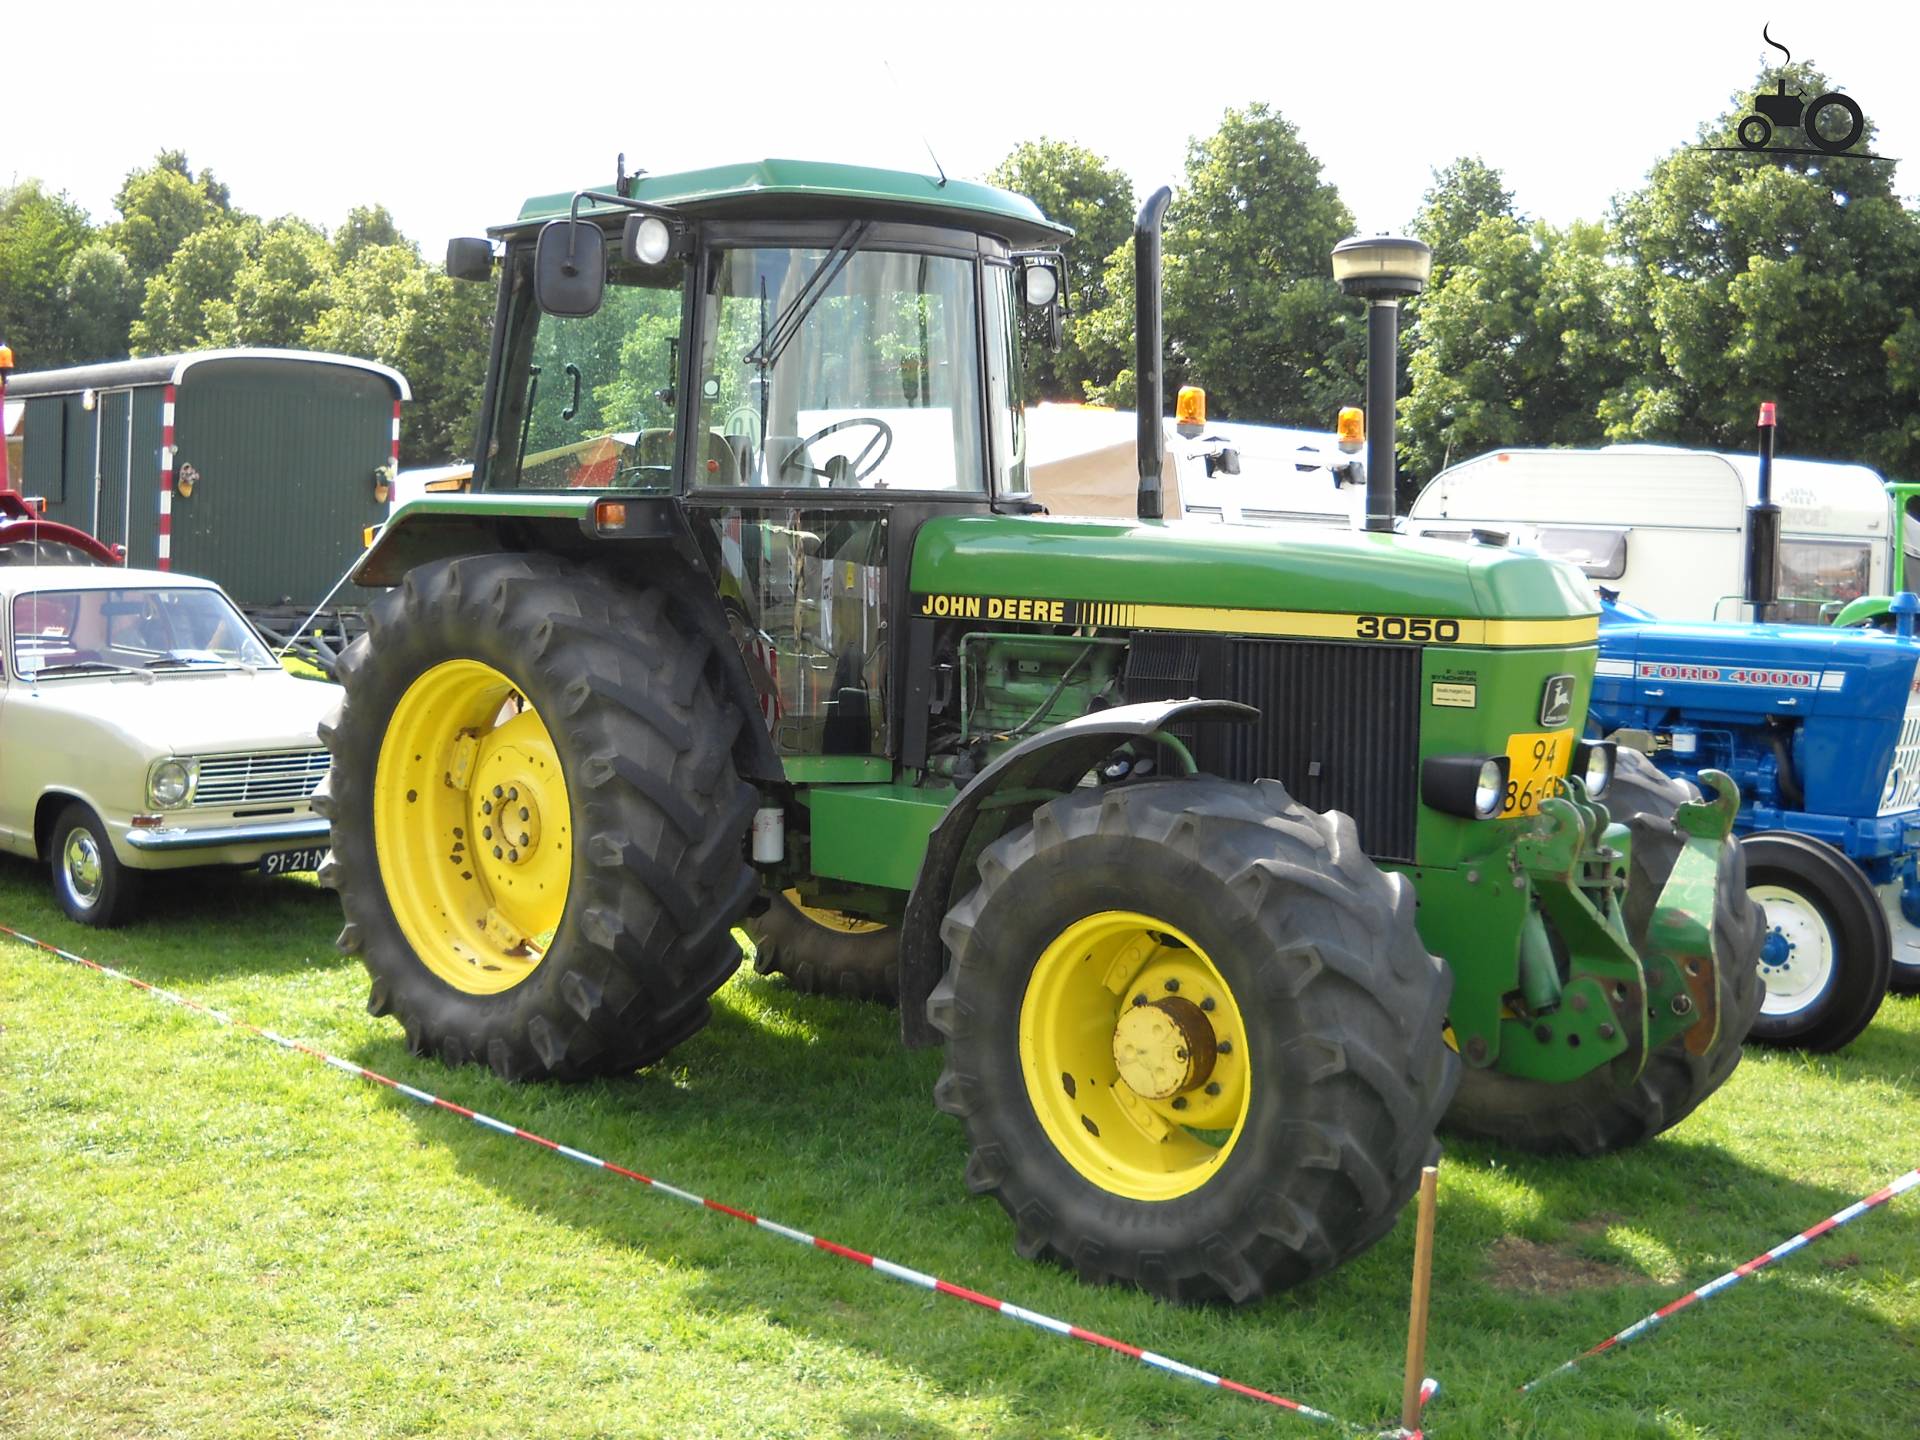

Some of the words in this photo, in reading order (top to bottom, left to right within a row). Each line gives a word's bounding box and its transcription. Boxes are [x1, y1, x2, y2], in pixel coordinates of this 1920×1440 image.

[922, 595, 981, 617] JOHN
[987, 598, 1065, 623] DEERE
[1356, 616, 1460, 642] 3050
[1640, 664, 1721, 682] FORD
[1728, 669, 1812, 687] 4000
[1533, 738, 1558, 772] 94
